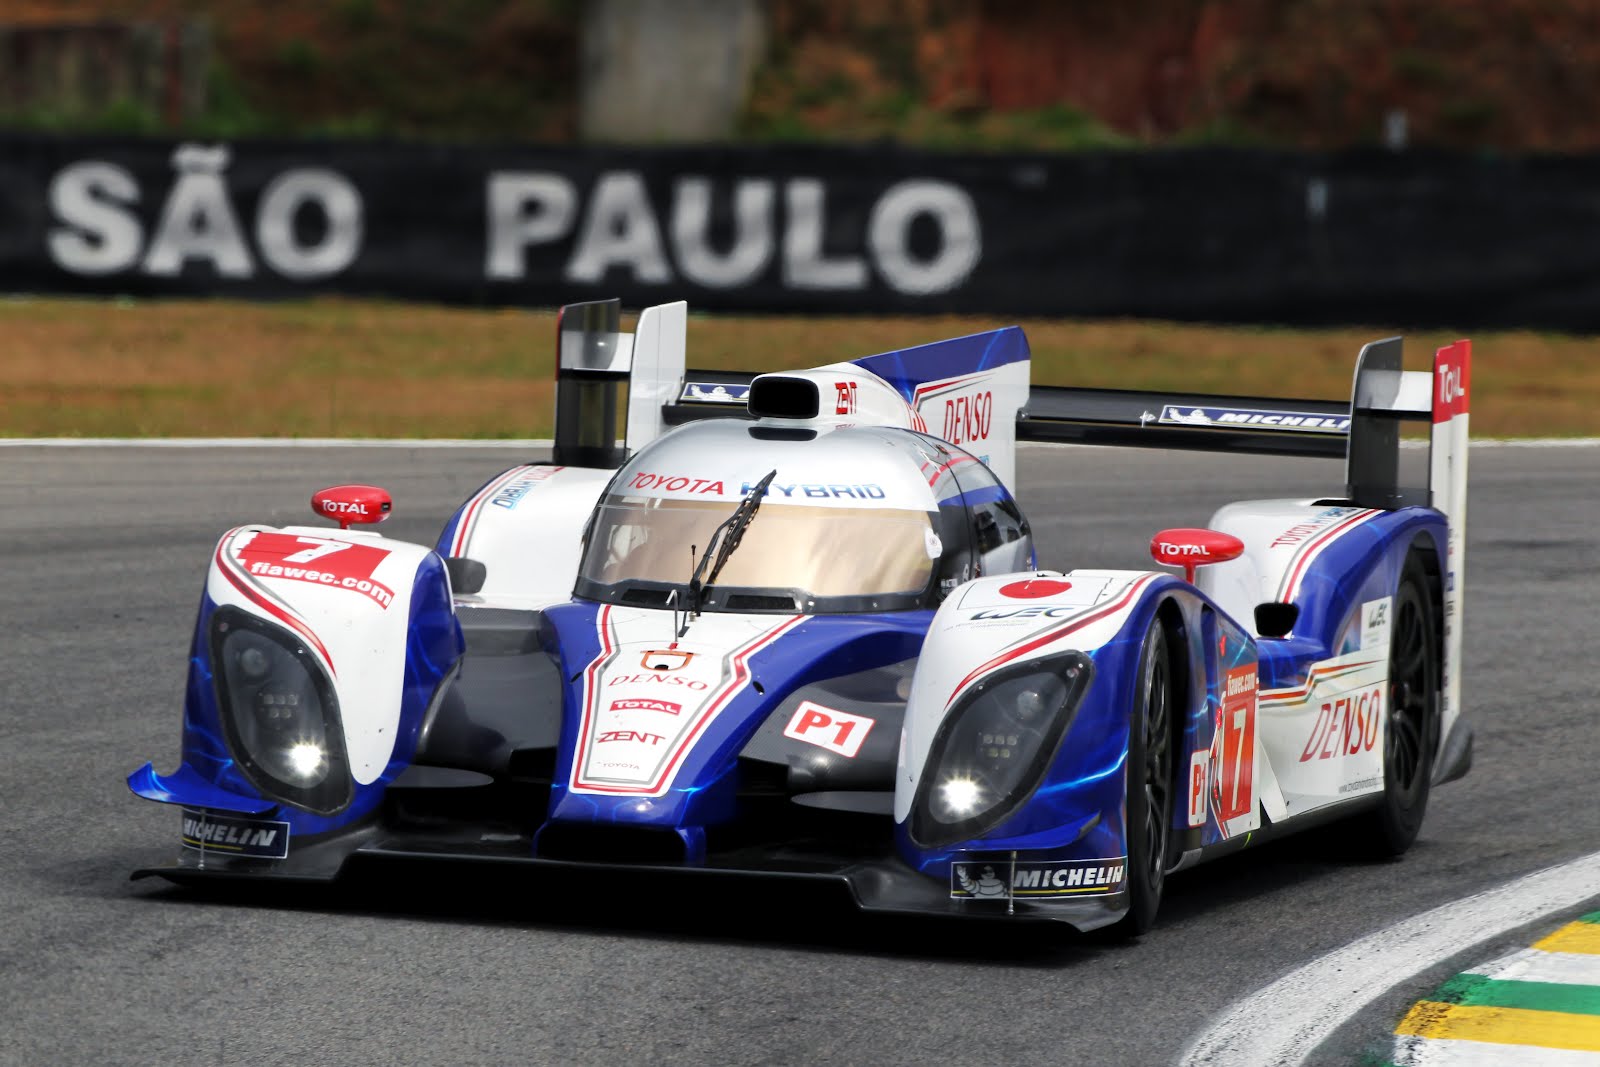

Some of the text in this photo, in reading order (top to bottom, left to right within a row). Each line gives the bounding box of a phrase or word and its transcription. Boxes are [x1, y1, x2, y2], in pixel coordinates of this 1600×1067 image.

[49, 145, 982, 295] SÃO PAULO
[834, 381, 858, 415] ZENT
[943, 391, 992, 445] DENSO
[1216, 412, 1350, 429] MICHELI
[627, 471, 887, 500] TOYOTA HYBRID
[322, 498, 369, 515] TOTAL
[282, 536, 354, 564] 7
[1159, 542, 1211, 556] TOTAL
[250, 560, 392, 602] fiawec.com
[608, 674, 708, 691] DENSO
[613, 700, 678, 714] TOTAL
[597, 730, 667, 746] ZENT
[793, 709, 857, 747] P1
[1299, 688, 1381, 763] DENSO
[602, 762, 640, 771] TOYOTA
[1231, 708, 1247, 812] 7
[1191, 762, 1207, 816] P1
[184, 818, 277, 847] MICHELIN
[1014, 865, 1124, 888] MICHELIN
